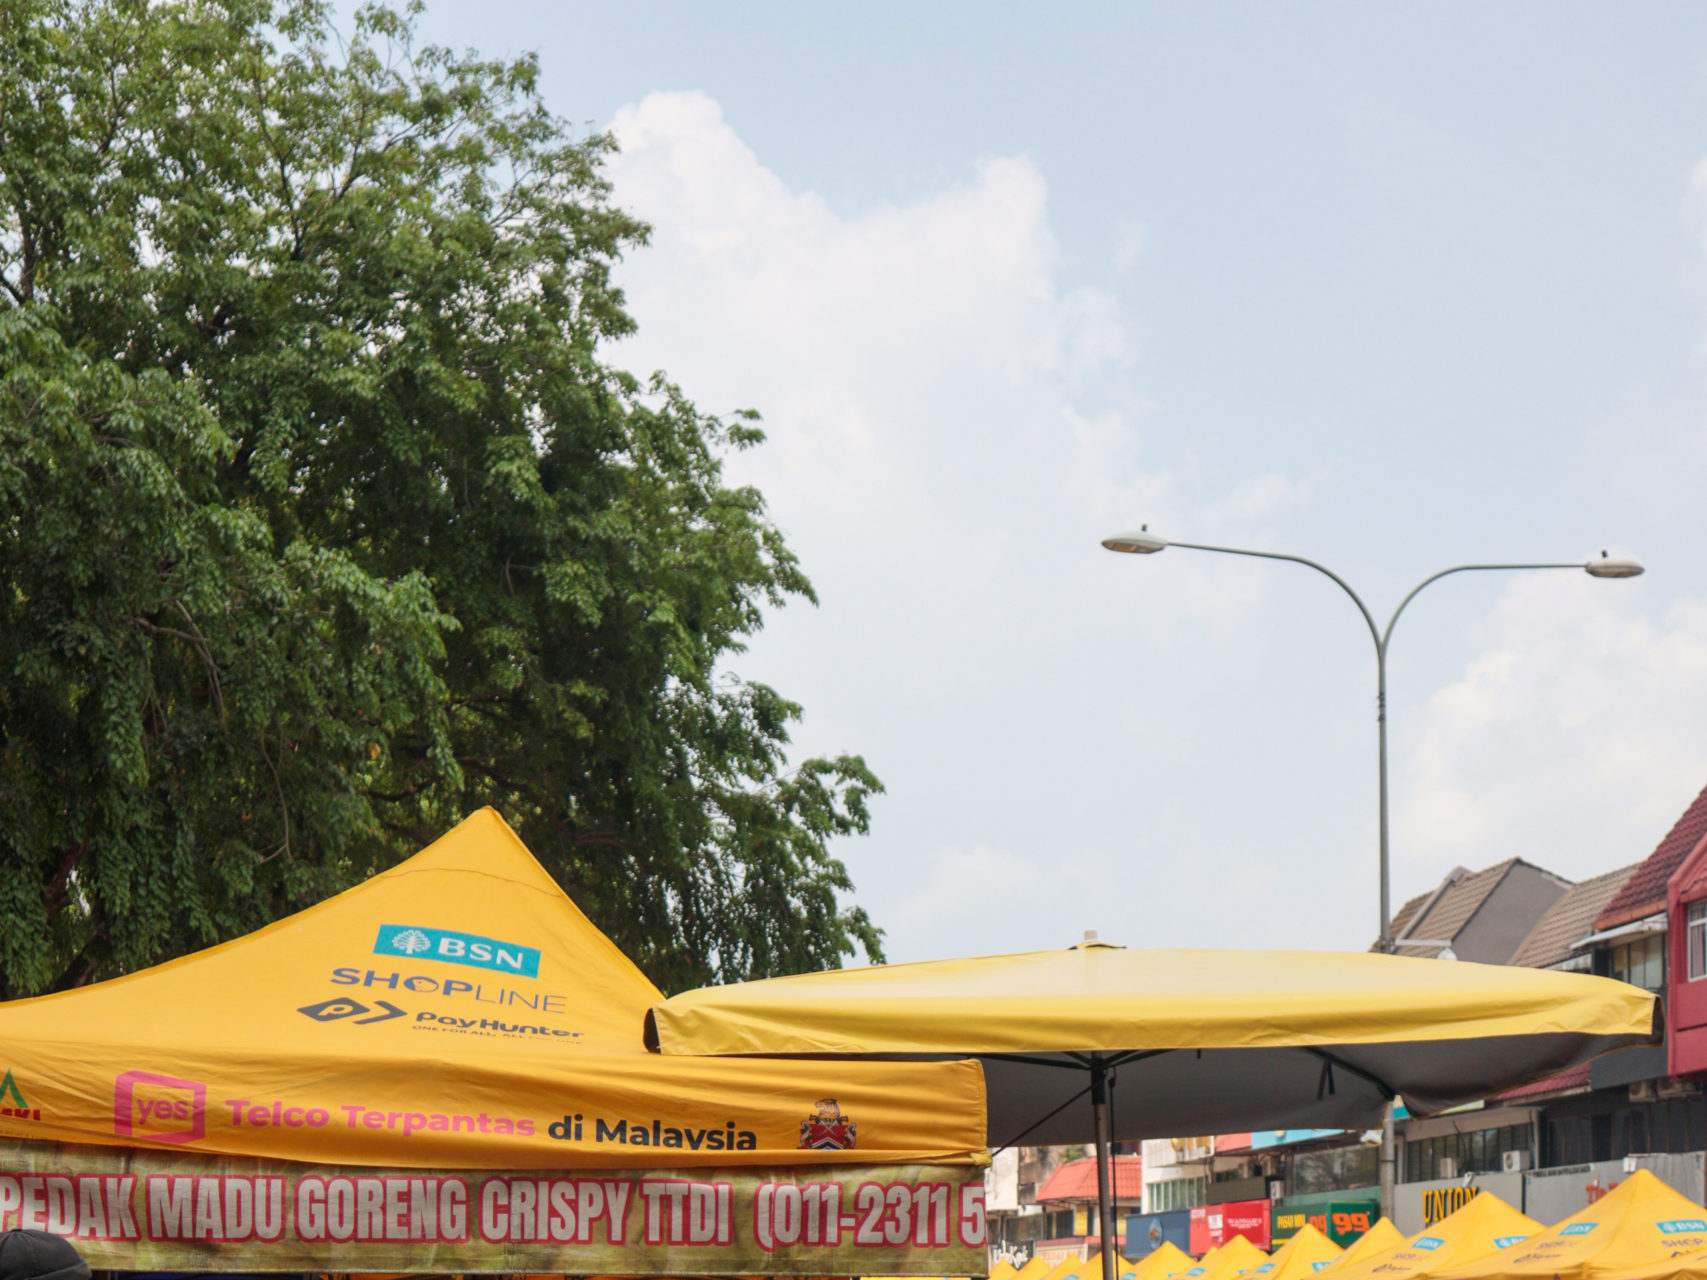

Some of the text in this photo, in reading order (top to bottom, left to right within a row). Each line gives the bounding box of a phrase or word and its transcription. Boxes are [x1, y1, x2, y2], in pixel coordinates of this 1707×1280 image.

[438, 936, 524, 970] BSN
[330, 967, 568, 1015] SHOPLINE
[415, 1011, 585, 1038] PayHunter
[136, 1098, 190, 1126] yes
[225, 1099, 331, 1128] Telco
[340, 1104, 536, 1137] Terpantas
[547, 1113, 584, 1141] di
[146, 1174, 286, 1242] MADU
[295, 1175, 471, 1243] GORENG
[479, 1176, 634, 1245] CRISPY
[640, 1179, 733, 1246] TTDI
